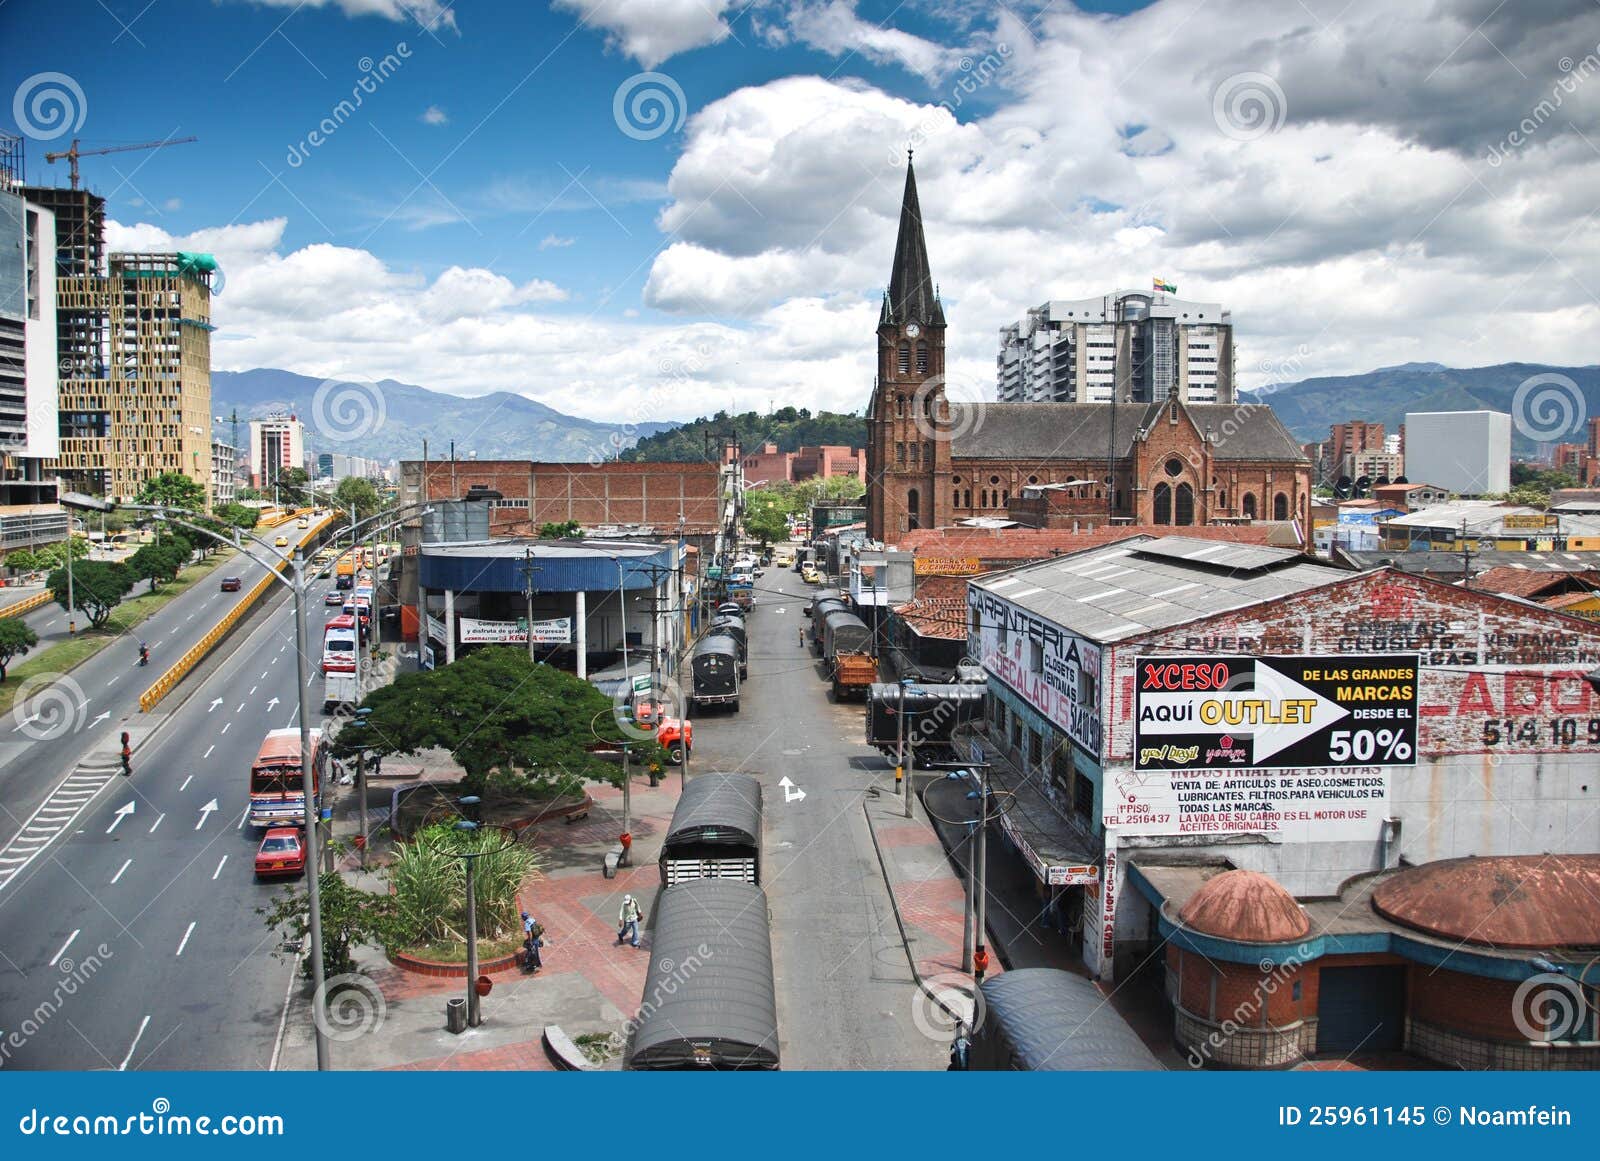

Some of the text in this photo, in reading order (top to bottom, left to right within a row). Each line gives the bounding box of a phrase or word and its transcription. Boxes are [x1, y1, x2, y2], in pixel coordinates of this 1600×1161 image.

[968, 586, 1083, 671] CARPINTERIA
[1044, 654, 1075, 682] CLOSETS
[1303, 668, 1414, 681] DE LAS GRANDES
[1142, 663, 1229, 690] XCESO
[1336, 686, 1413, 701] MARCAS
[1141, 698, 1318, 725] AQUÍ OUTLET
[1353, 707, 1412, 719] DESDE EL
[1480, 719, 1539, 746] 514
[1550, 718, 1577, 745] 10
[1328, 728, 1413, 762] 50%
[1171, 781, 1201, 790] VENTA
[1223, 779, 1276, 789] ARTICULOS
[1280, 779, 1294, 788] DE
[1317, 789, 1369, 799] VEHICULOS
[1371, 789, 1384, 798] EN
[1179, 803, 1210, 813] TODAS
[1213, 803, 1232, 812] LAS
[1179, 810, 1367, 823] LA VIDA DE SU CARRO ES EL MOTOR USE
[1179, 822, 1219, 832] ACEITES
